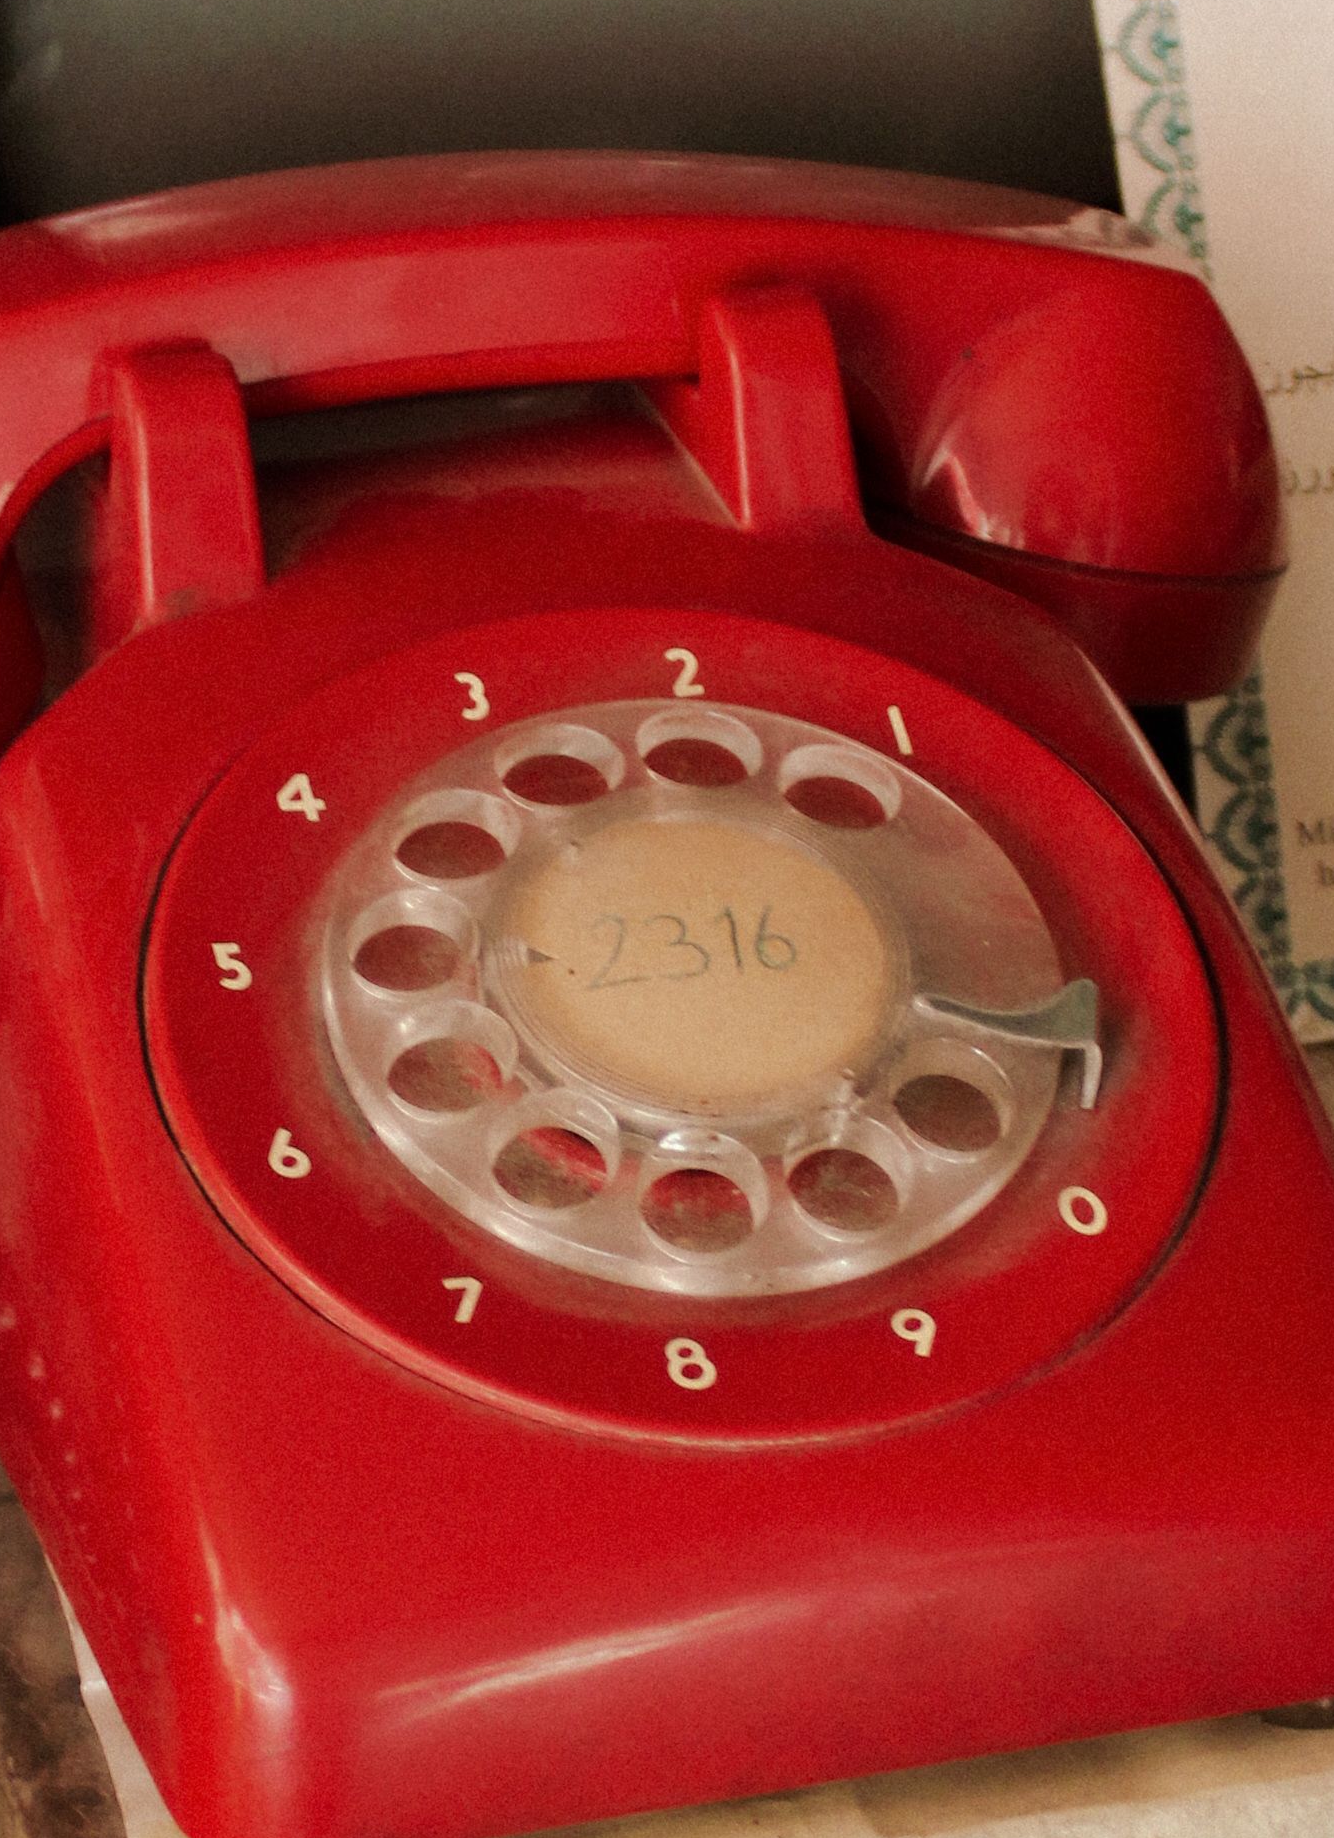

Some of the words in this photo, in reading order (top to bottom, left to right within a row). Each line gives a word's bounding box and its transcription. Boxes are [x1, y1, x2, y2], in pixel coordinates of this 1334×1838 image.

[453, 671, 491, 722] 3
[664, 647, 706, 699] 2
[886, 704, 913, 756] 1
[275, 772, 327, 823] 4
[210, 941, 253, 991] 5
[589, 905, 798, 990] 2316
[267, 1127, 312, 1179] 6
[441, 1276, 483, 1324] 7
[890, 1307, 937, 1358] 9
[664, 1337, 718, 1391] 8
